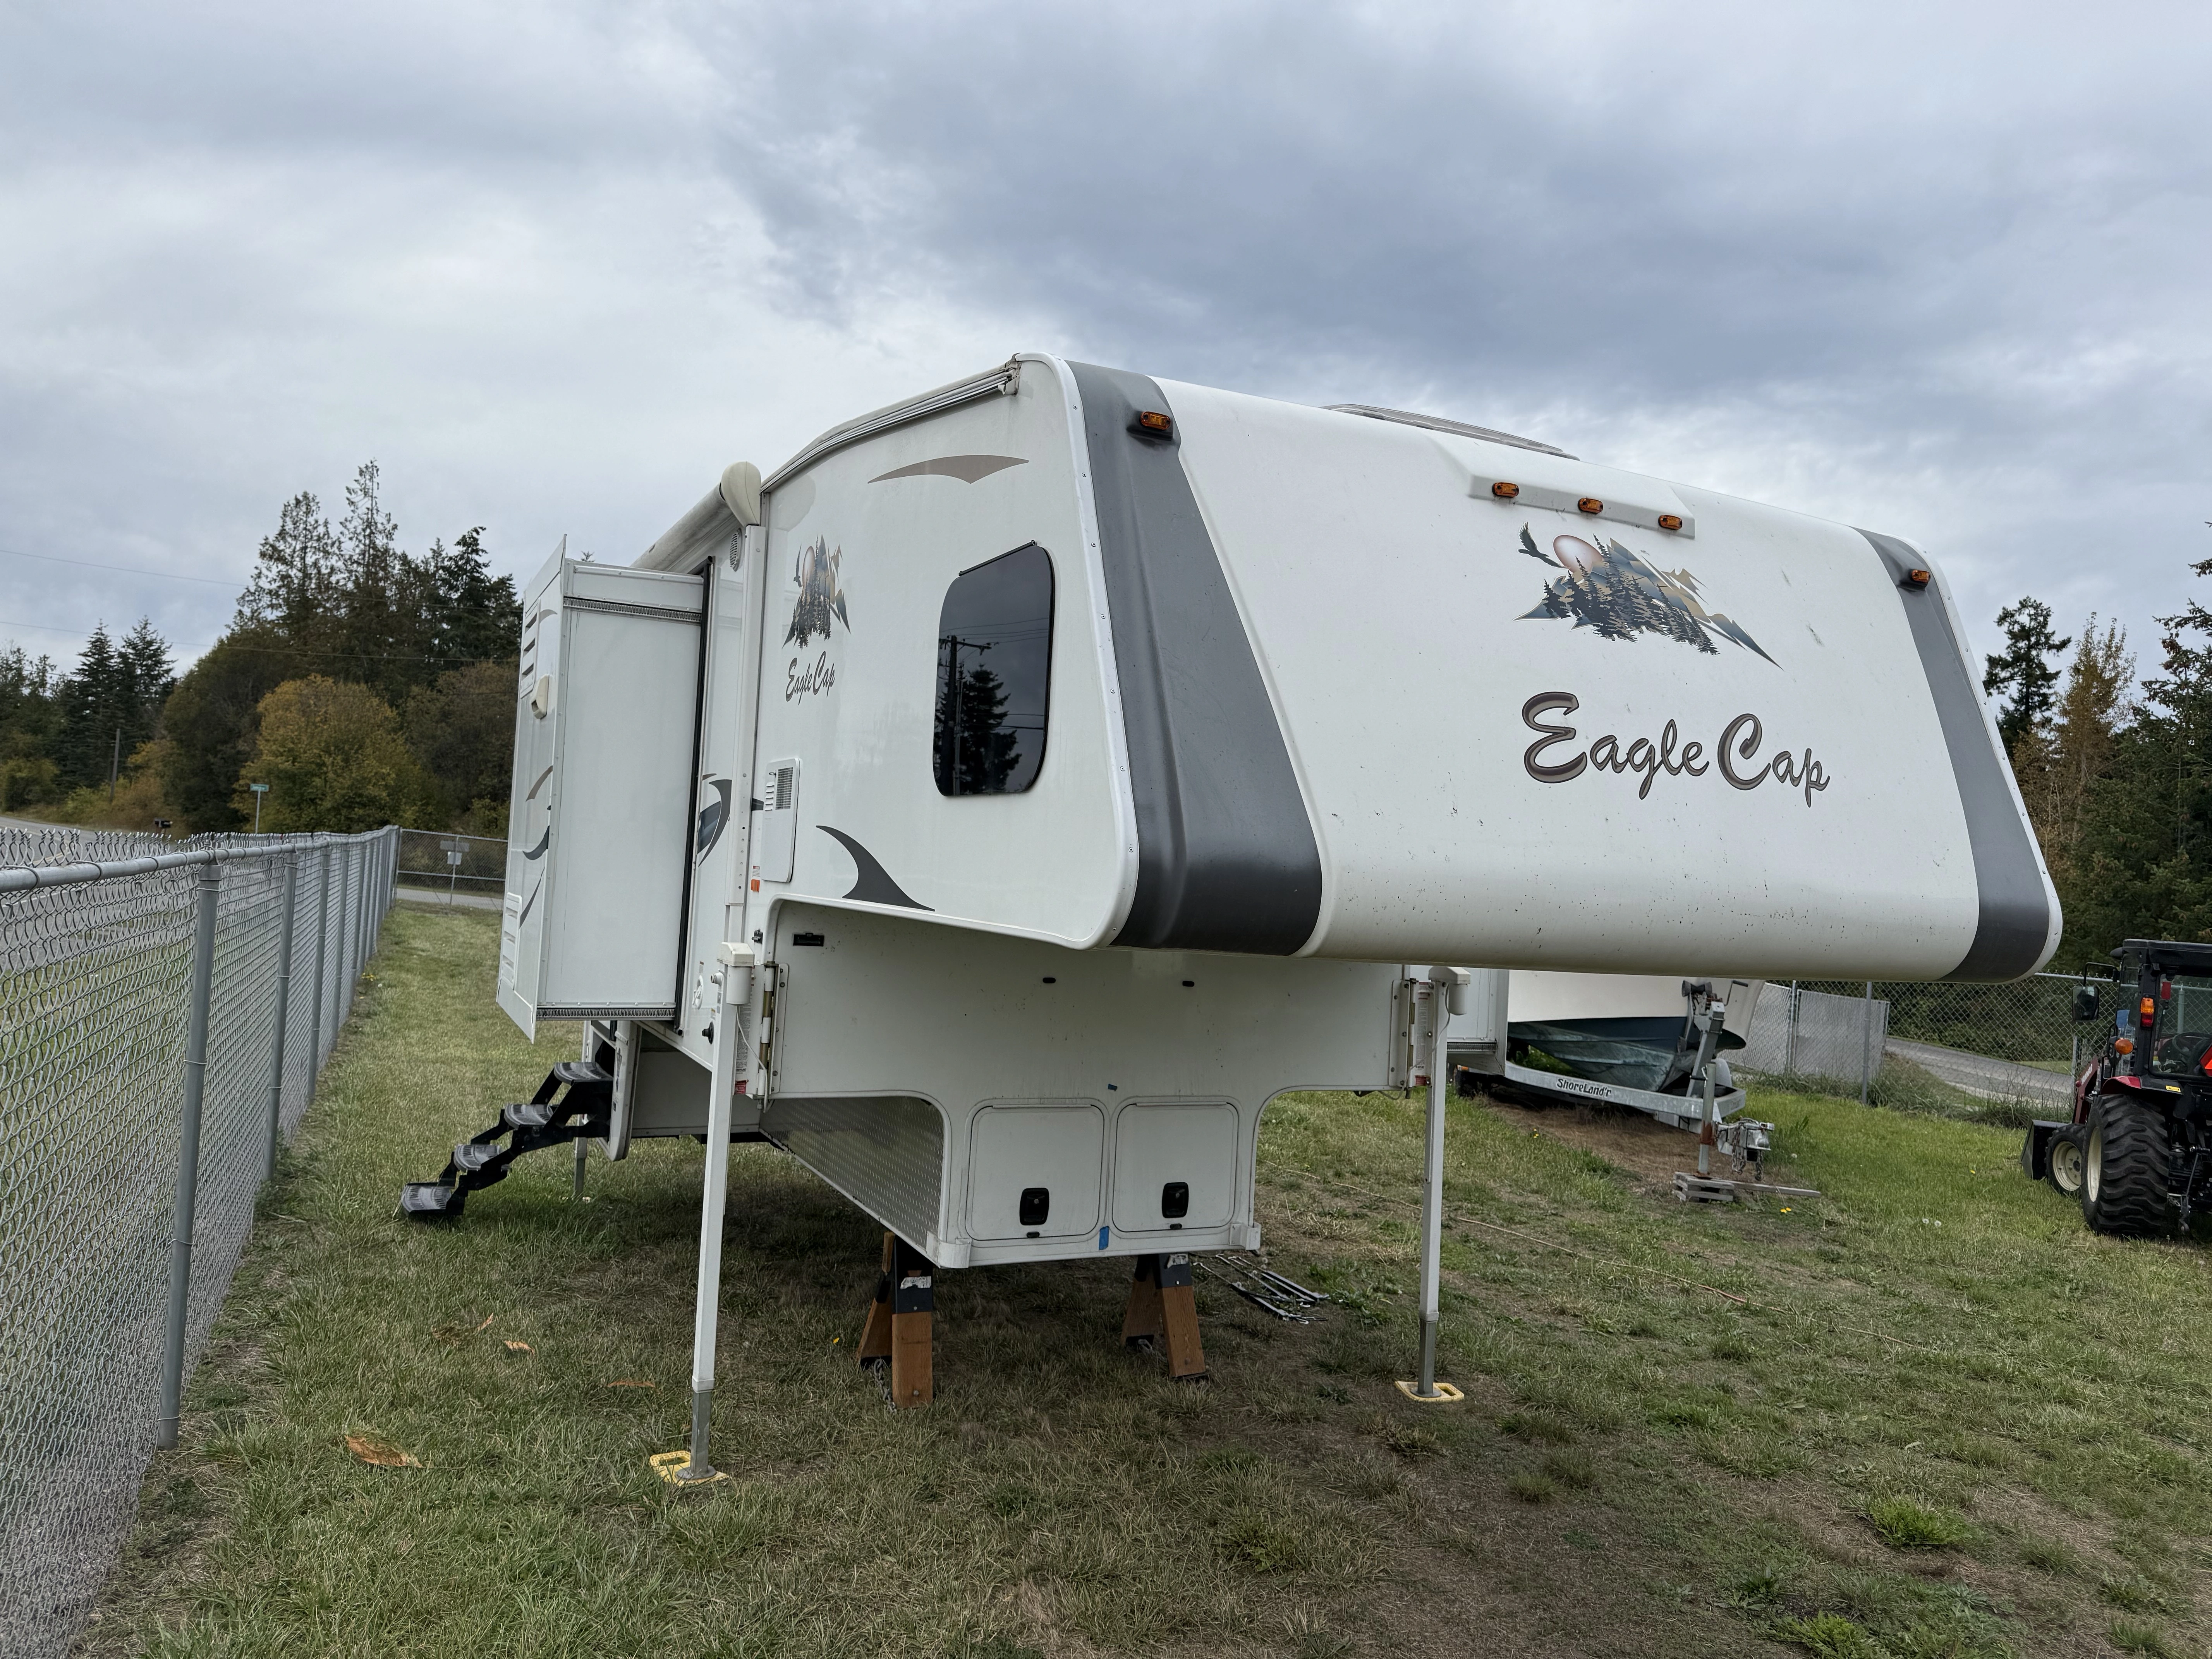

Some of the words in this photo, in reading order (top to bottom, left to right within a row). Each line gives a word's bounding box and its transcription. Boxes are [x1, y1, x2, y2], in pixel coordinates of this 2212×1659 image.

[785, 657, 812, 706] Eagle
[813, 651, 836, 698] Cap
[1522, 691, 1710, 800] Eagle
[1717, 713, 1831, 808] Cap
[1557, 1079, 1611, 1097] ShoreLand'r
